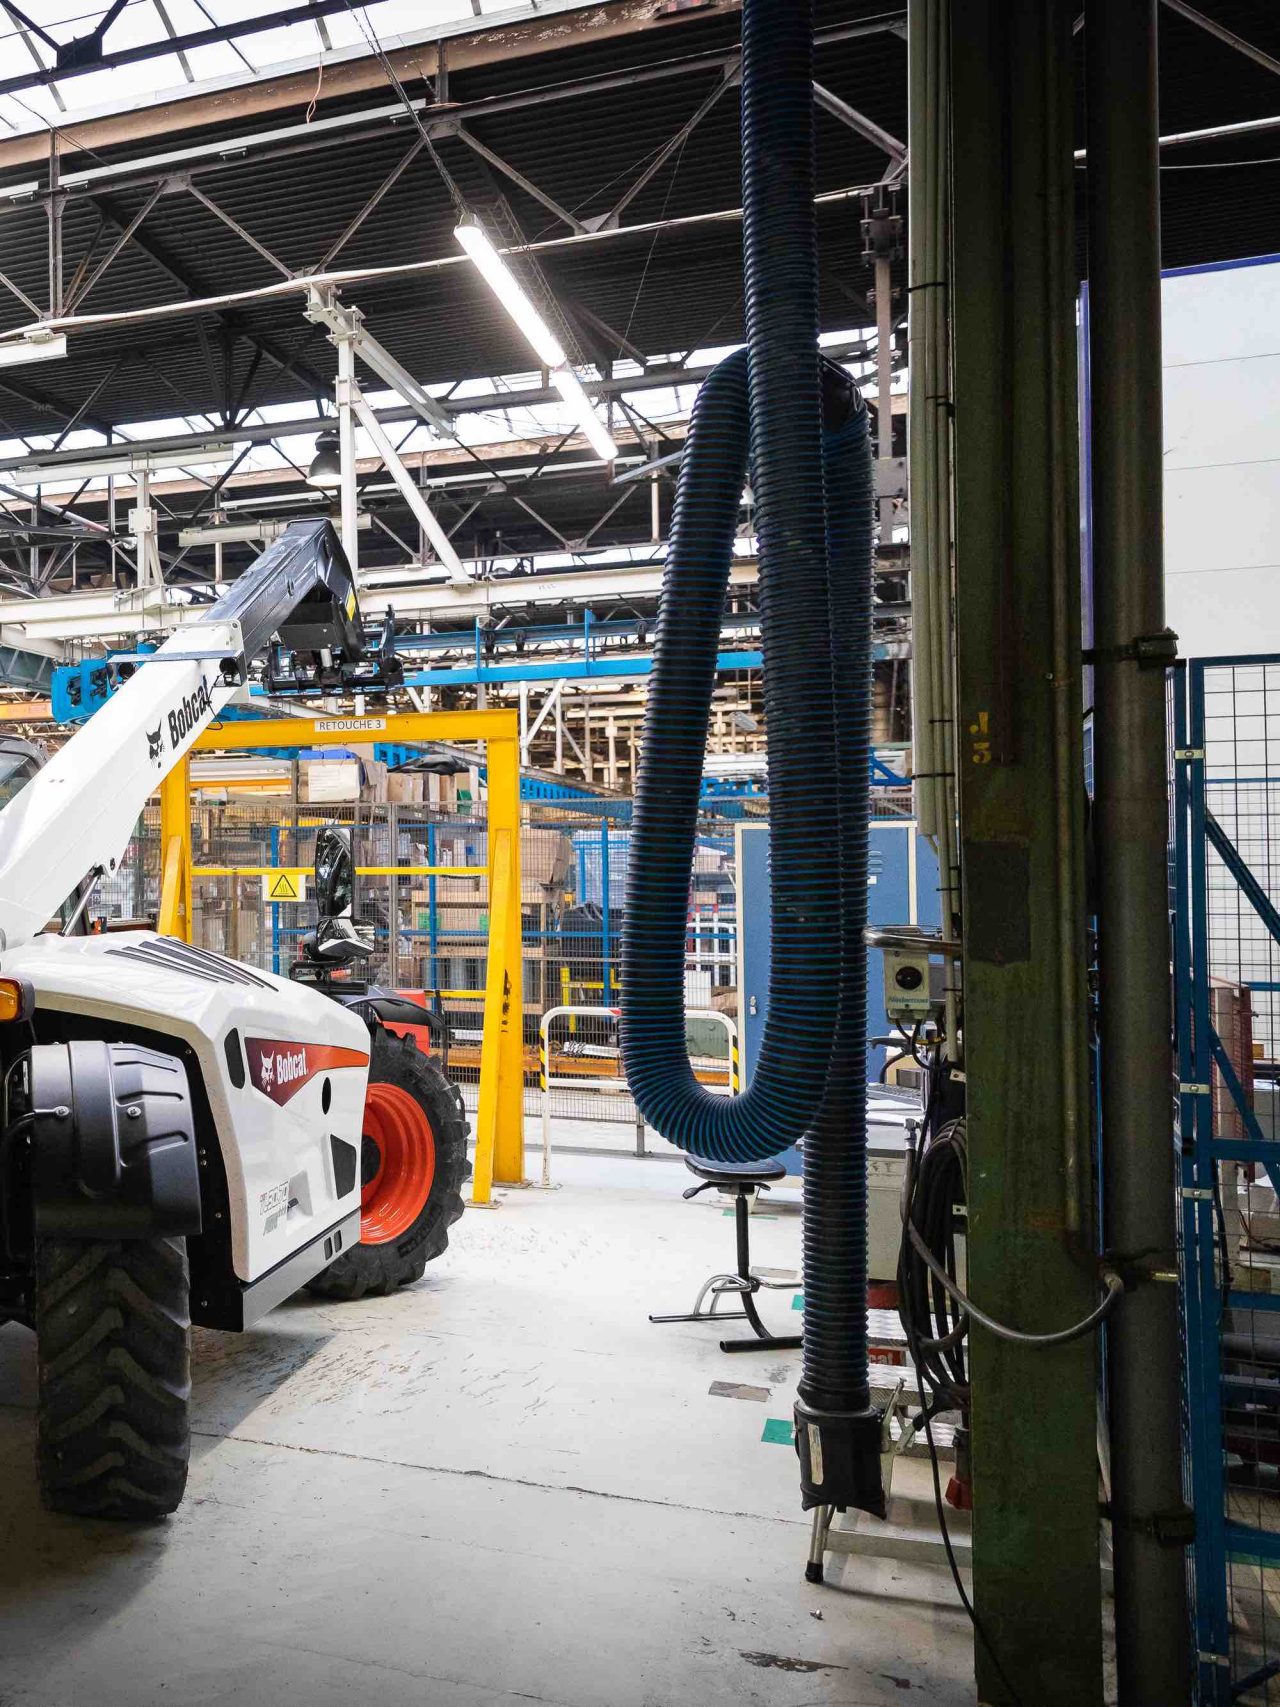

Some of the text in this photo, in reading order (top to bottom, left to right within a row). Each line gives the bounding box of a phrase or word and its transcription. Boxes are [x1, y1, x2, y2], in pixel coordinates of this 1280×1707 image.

[167, 674, 208, 750] Bobcat
[319, 719, 381, 731] RETOUCHE 3
[972, 742, 991, 764] 5
[276, 1047, 307, 1085] Bobcat
